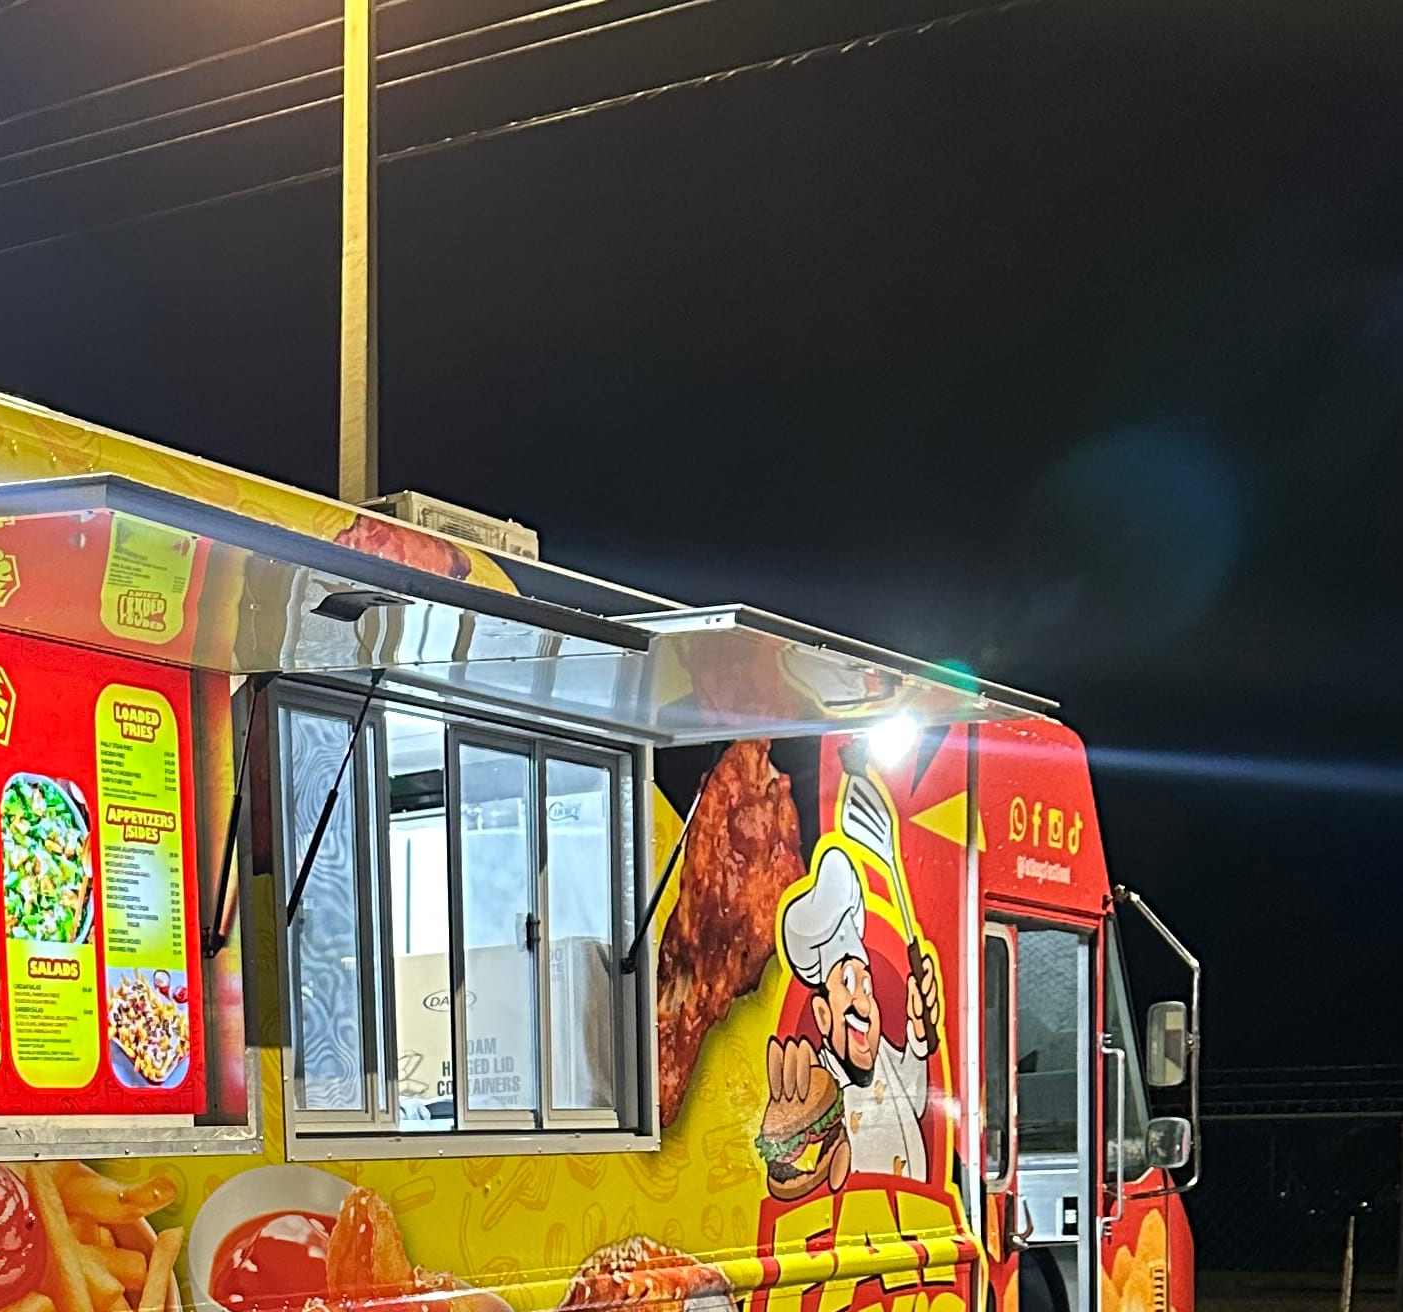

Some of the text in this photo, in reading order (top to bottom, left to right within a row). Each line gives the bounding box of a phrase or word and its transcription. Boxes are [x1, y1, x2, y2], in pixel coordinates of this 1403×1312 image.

[114, 704, 160, 727] LOADED
[122, 721, 154, 740] FRIES
[107, 807, 175, 830] APPETIZERS
[29, 960, 79, 978] SALADS
[467, 1038, 497, 1055] OAM
[442, 1056, 515, 1077] HGED LID
[437, 1075, 522, 1097] COAINERS
